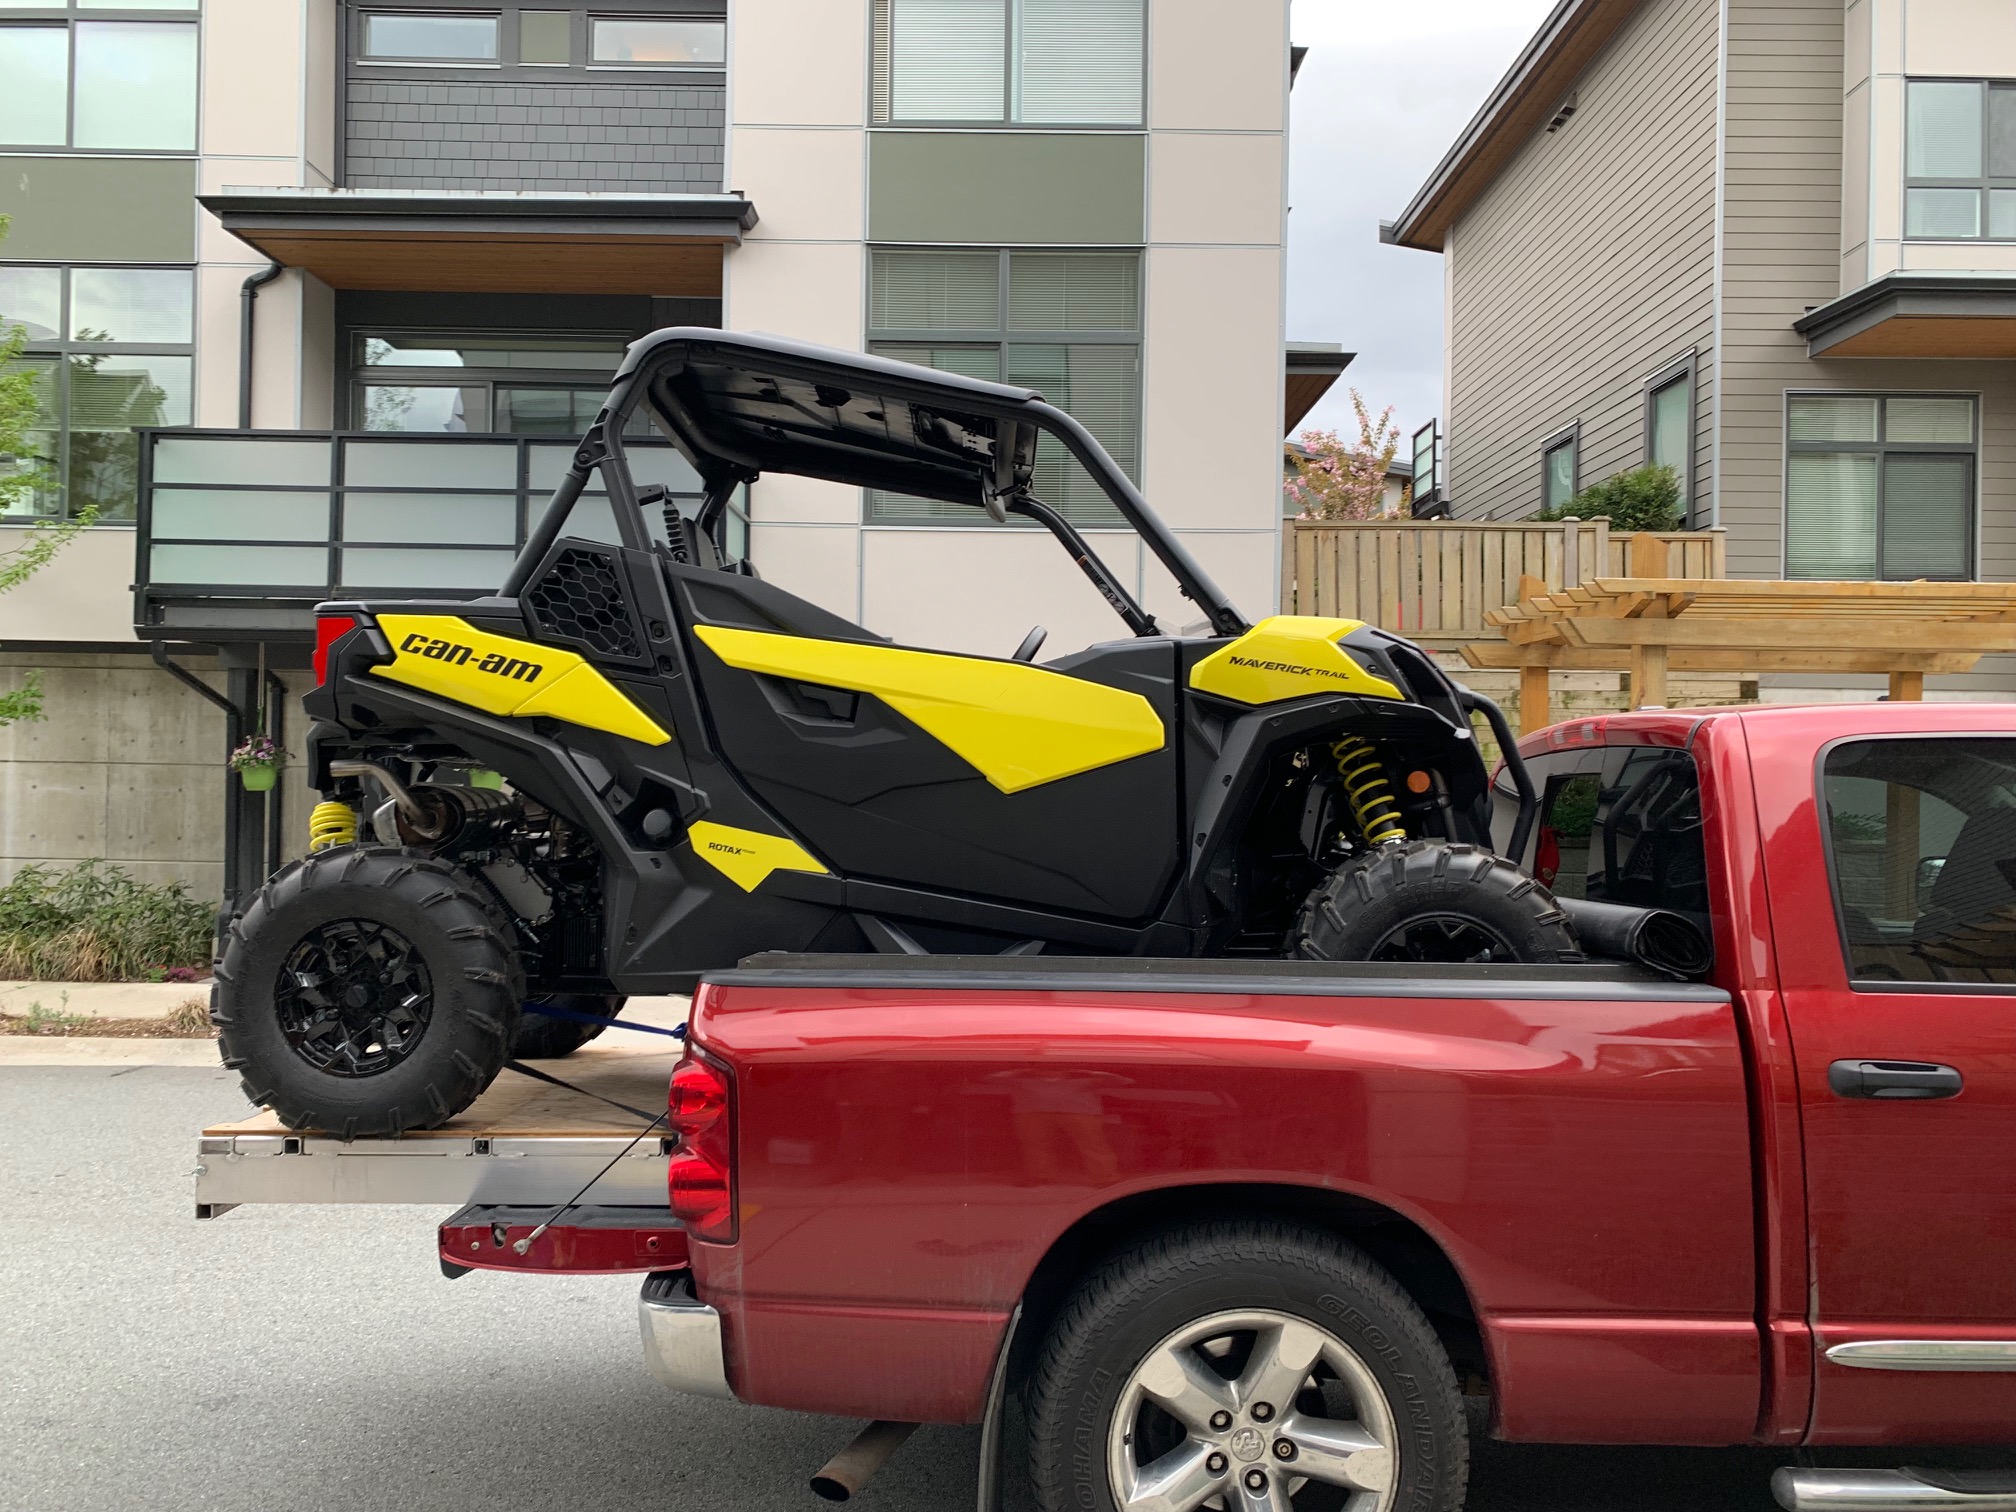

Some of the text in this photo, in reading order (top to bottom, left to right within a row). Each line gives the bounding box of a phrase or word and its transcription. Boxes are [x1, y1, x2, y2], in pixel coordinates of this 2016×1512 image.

[1228, 656, 1350, 680] MAVERICK TRAIL
[708, 842, 742, 855] ROTAX
